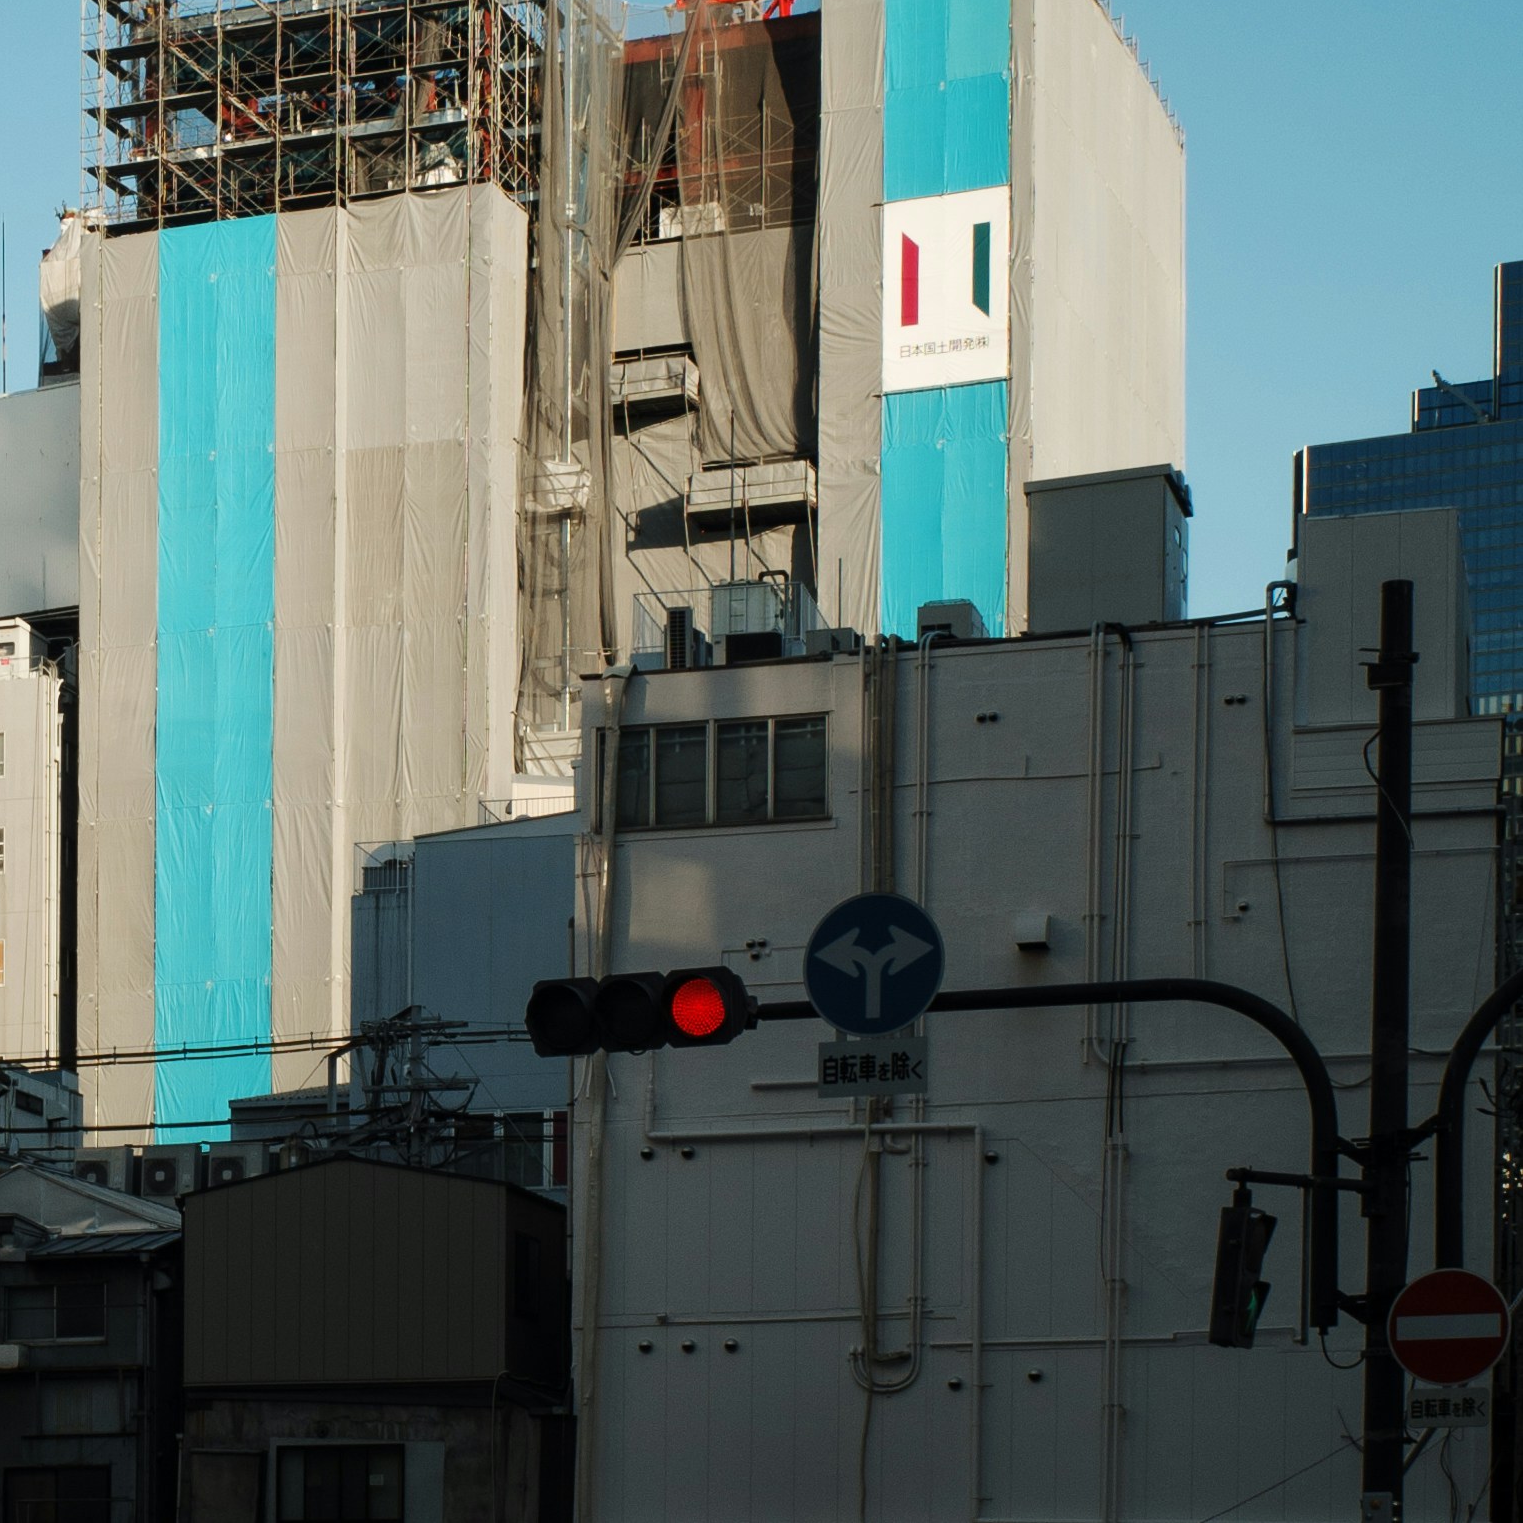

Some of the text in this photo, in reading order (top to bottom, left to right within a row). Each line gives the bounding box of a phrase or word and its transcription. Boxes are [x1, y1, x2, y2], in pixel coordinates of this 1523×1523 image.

[822, 1051, 923, 1085] 自転車を除く
[1410, 1396, 1486, 1419] 自転車を除く
